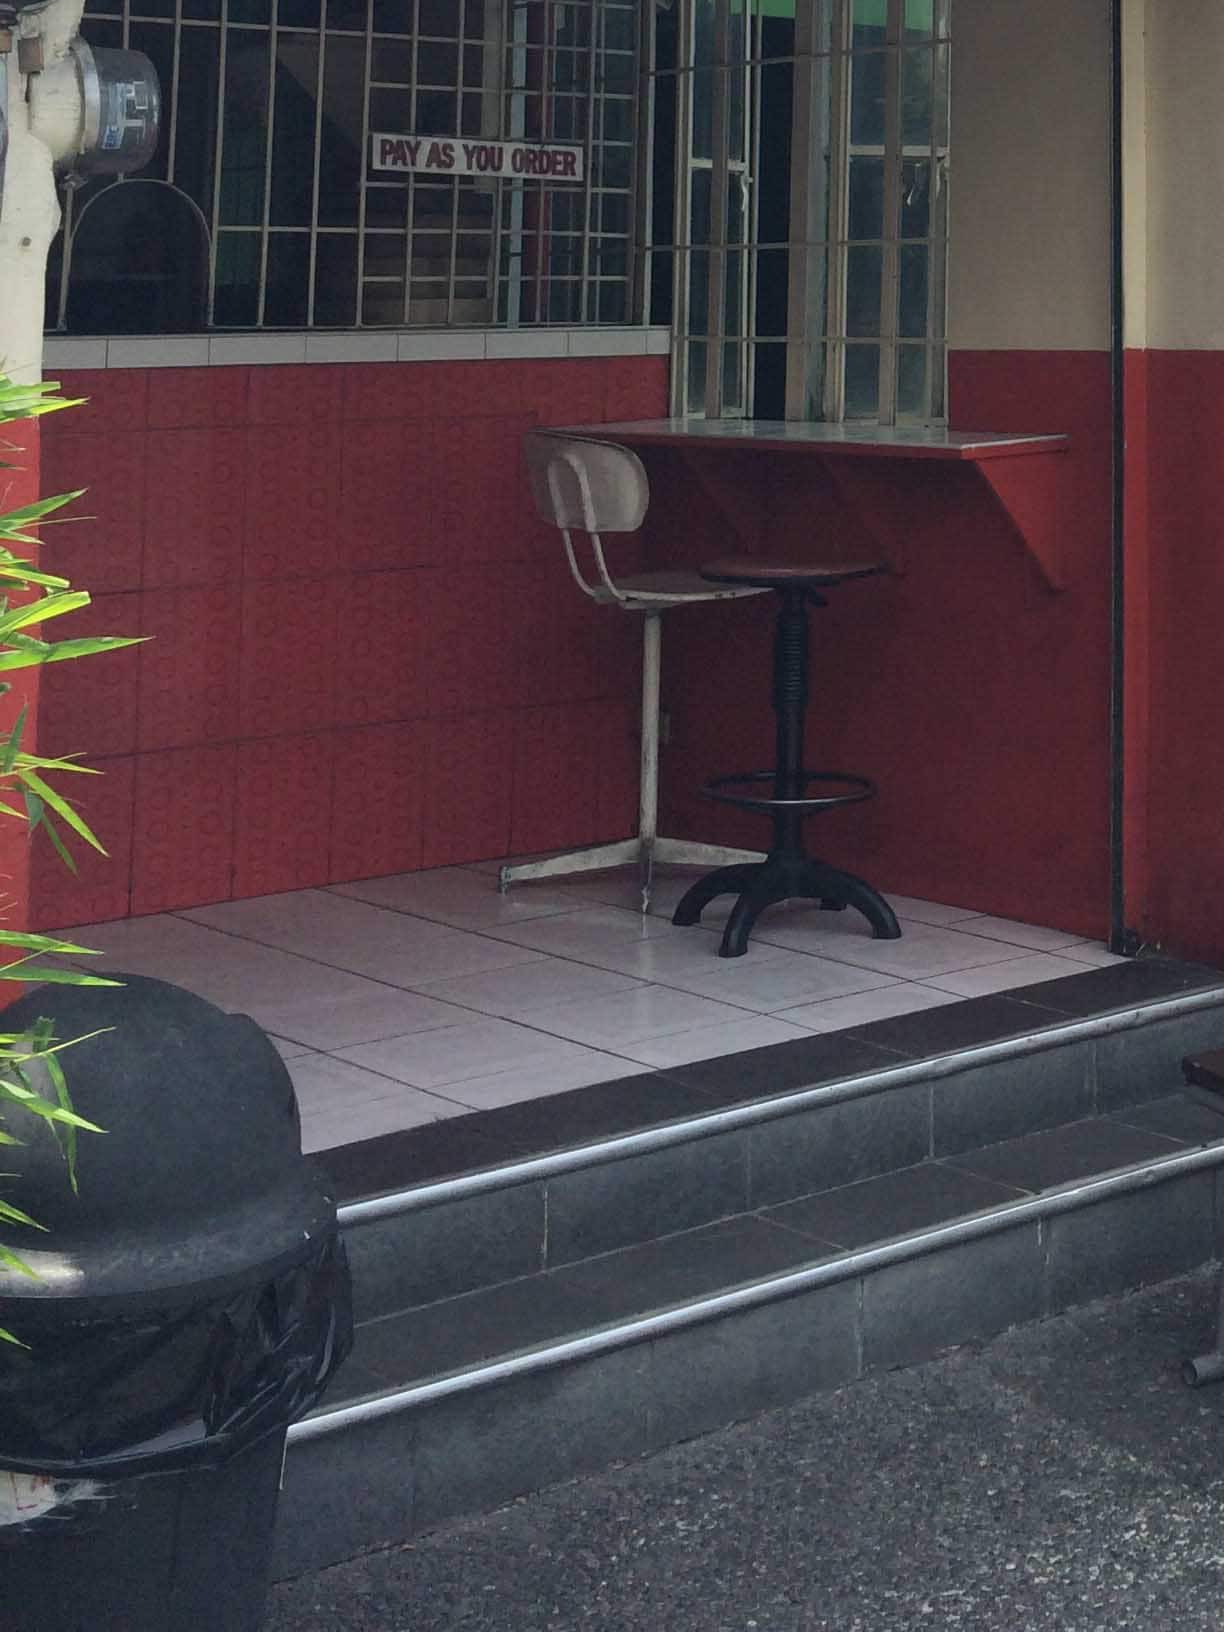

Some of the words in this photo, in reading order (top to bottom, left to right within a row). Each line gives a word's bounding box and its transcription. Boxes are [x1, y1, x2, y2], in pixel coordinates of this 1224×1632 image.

[379, 139, 421, 167] PAY
[425, 142, 455, 168] AS
[462, 144, 503, 172] YOU
[511, 148, 577, 176] ORDER
